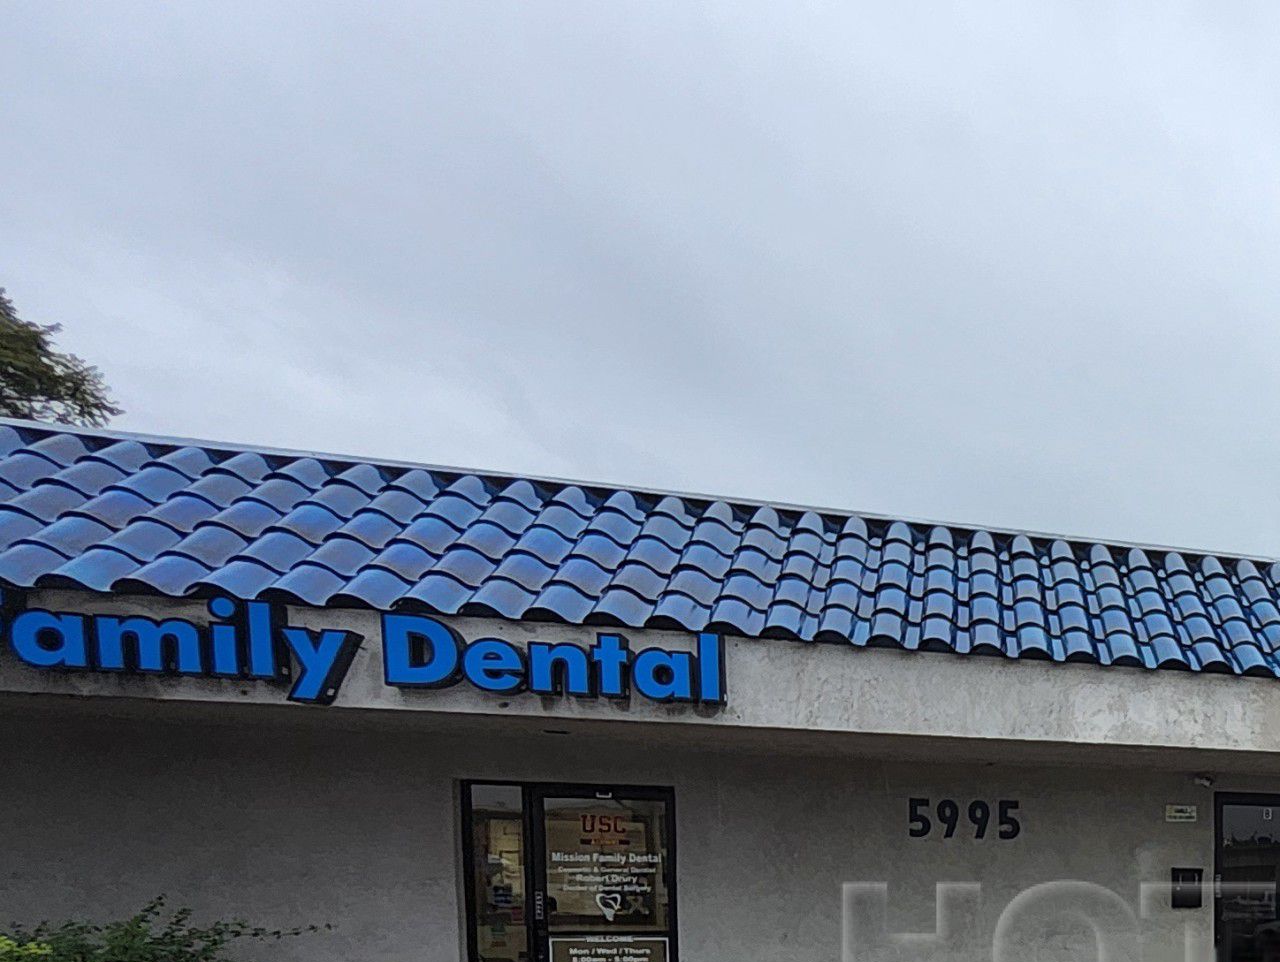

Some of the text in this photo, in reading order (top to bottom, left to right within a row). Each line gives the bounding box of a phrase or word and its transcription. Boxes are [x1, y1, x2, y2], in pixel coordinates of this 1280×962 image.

[0, 592, 727, 703] amily Dental
[581, 814, 627, 833] USC
[909, 797, 1021, 840] 5995
[551, 852, 662, 864] Mission Family Dental
